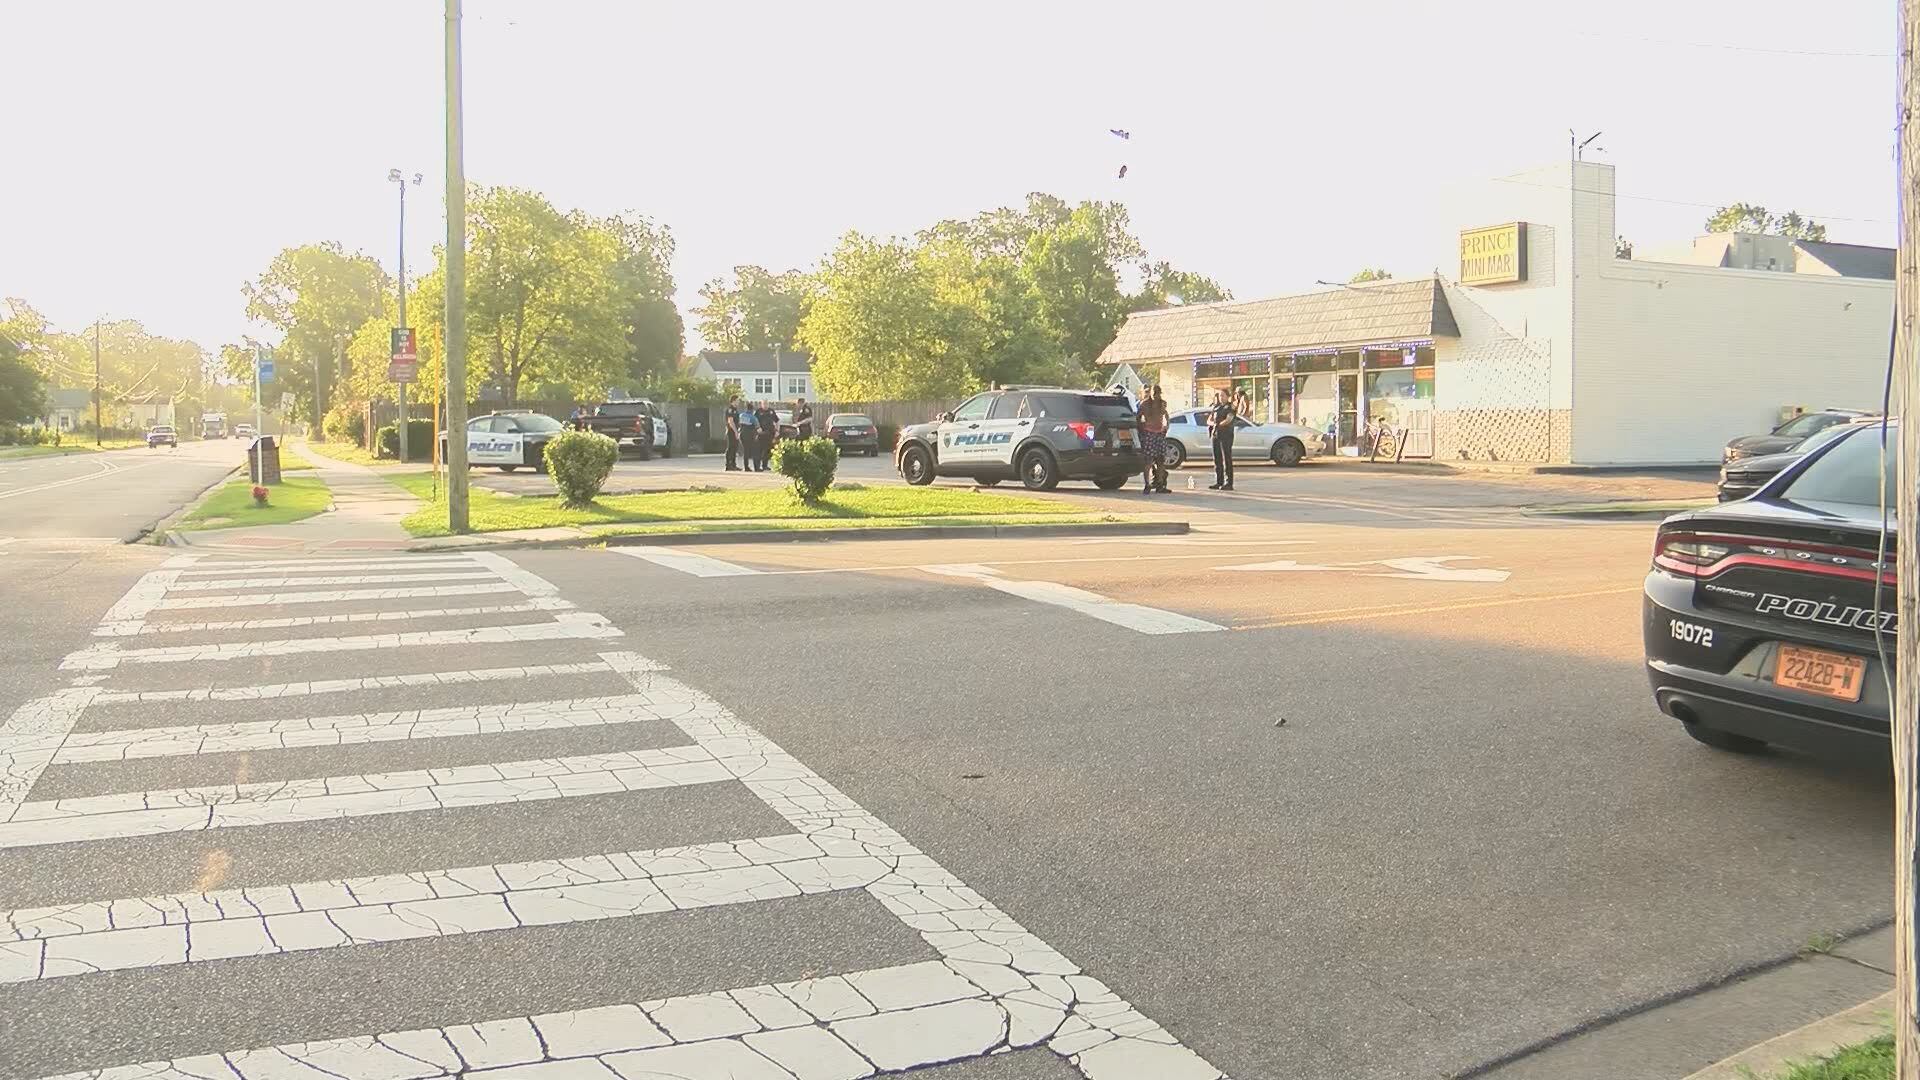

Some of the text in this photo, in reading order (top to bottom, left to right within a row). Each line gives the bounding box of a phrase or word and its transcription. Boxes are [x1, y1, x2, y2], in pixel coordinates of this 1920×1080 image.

[1462, 231, 1515, 255] PRINCE
[1462, 254, 1515, 277] MINI MART
[468, 442, 514, 452] POLICE
[954, 432, 1014, 446] POLICE
[1669, 619, 1713, 647] 19072
